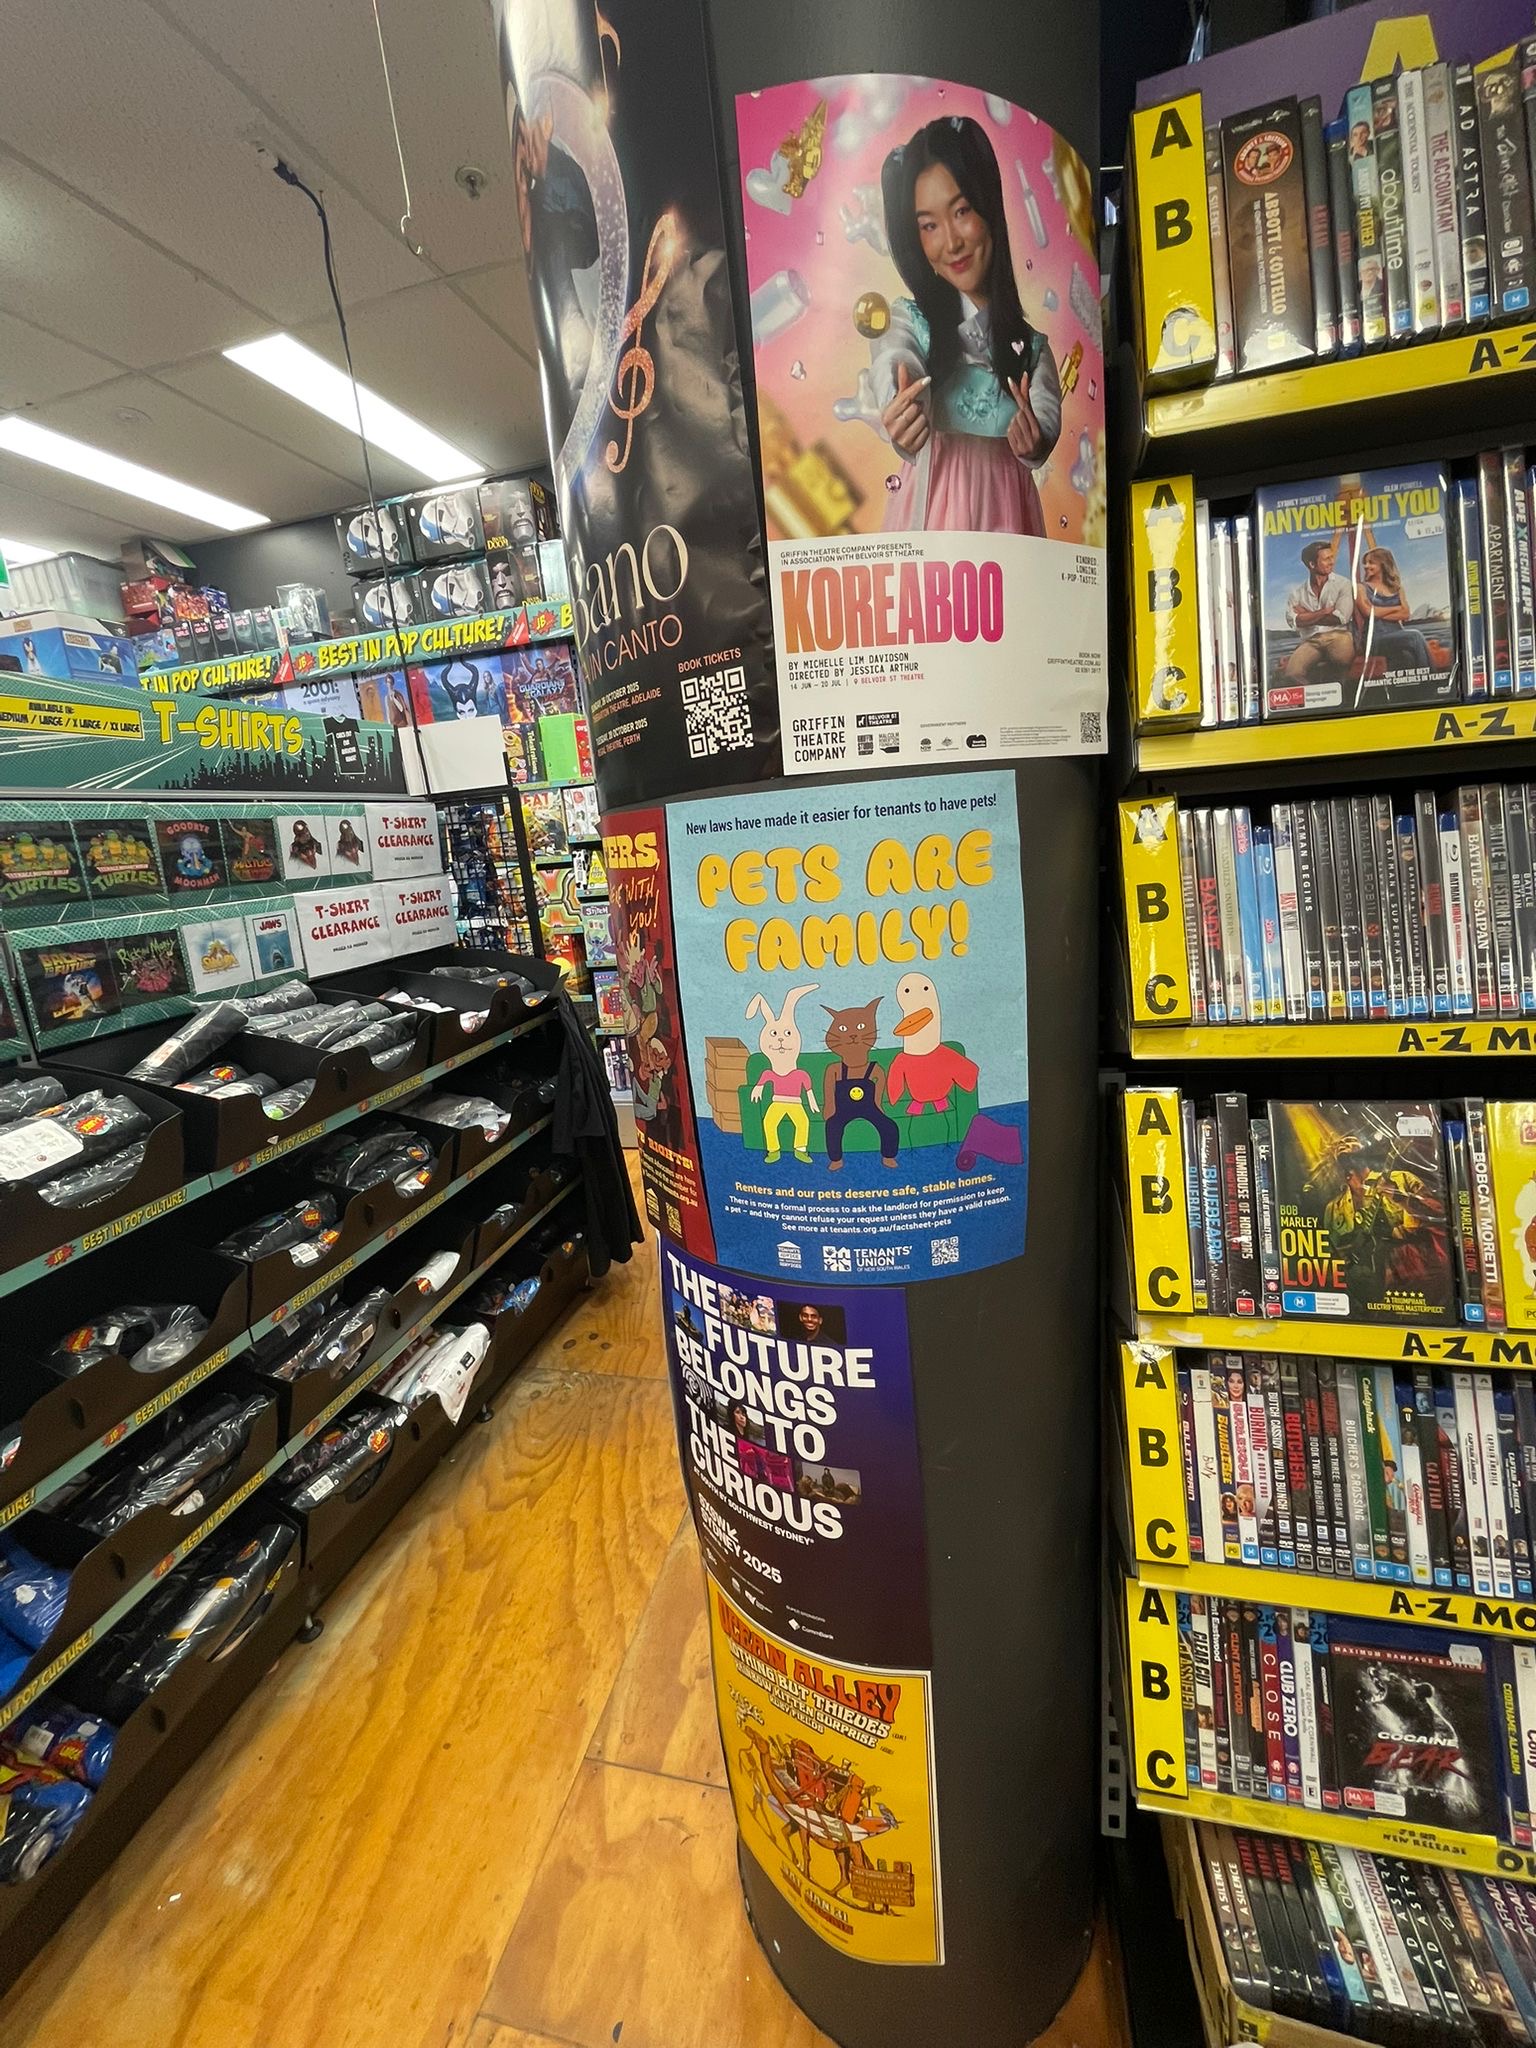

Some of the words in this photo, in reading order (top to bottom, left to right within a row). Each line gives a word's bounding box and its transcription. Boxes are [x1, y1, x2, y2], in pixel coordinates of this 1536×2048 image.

[1150, 107, 1193, 160] A
[1459, 104, 1474, 132] AD
[1431, 130, 1448, 155] THE
[1432, 155, 1455, 235] ACCOUNTANT
[1463, 147, 1480, 218] ASTRA
[1154, 198, 1194, 251] B
[1160, 313, 1206, 358] C
[1146, 483, 1185, 525] A
[1263, 499, 1347, 538] ANYONE
[1351, 494, 1391, 525] BUT
[1395, 486, 1441, 517] YOU
[780, 551, 808, 559] GRIFFIN
[809, 548, 841, 557] THEATRE
[841, 545, 875, 554] COMPANY
[876, 543, 913, 551] PRESENTS
[1488, 523, 1506, 601] APARTMENT
[780, 560, 1004, 655] KOREABOO
[1147, 567, 1182, 613] B
[298, 657, 309, 671] JB
[318, 643, 360, 669] BEST
[363, 641, 382, 662] IN
[384, 632, 418, 658] POP
[421, 615, 505, 652] CULTURE!
[589, 656, 603, 682] IN
[604, 614, 683, 671] CANTO
[678, 658, 702, 673] BOOK
[703, 648, 742, 667] TICKETS
[788, 661, 799, 671] BY
[803, 657, 844, 669] MICHELLE
[848, 655, 866, 666] LIM
[153, 675, 170, 694] IN
[172, 669, 200, 693] POP
[202, 656, 272, 688] CULTURE!
[301, 678, 340, 698] 2001:
[789, 669, 830, 681] DIRECTED
[834, 668, 845, 677] BY
[850, 664, 885, 676] JESSICA
[889, 662, 919, 673] ARTHUR
[1150, 665, 1189, 712] C
[792, 715, 845, 732] GRIFFIN
[793, 731, 846, 748] THEATRE
[1434, 706, 1515, 743] A-Z
[794, 746, 847, 763] COMPANY
[166, 821, 210, 835] GOODBYE
[382, 816, 427, 831] T-SHIRT
[686, 822, 707, 835] New
[709, 819, 733, 833] laws
[735, 816, 762, 831] have
[764, 812, 798, 828] made
[800, 810, 809, 825] it
[812, 807, 850, 823] easier
[853, 805, 872, 819] for
[875, 801, 922, 817] tenants
[924, 799, 937, 812] to
[939, 797, 968, 811] have
[970, 793, 998, 812] pets!
[1133, 803, 1169, 844] A
[1297, 808, 1309, 858] BATMAN
[377, 833, 434, 849] CLEARANCE
[1, 876, 82, 901] TURTLES
[91, 870, 159, 893] TURTLES
[173, 873, 221, 889] MOONMEN
[697, 843, 843, 909] PETS
[865, 828, 995, 897] ARE
[1301, 864, 1313, 912] BEGINS
[315, 898, 370, 919] T-SHIRT
[398, 889, 442, 906] T-SHIRT
[626, 875, 655, 905] WITH
[1136, 882, 1170, 924] B
[259, 918, 282, 932] JAWS
[311, 915, 381, 942] CLEARANCE
[395, 905, 450, 926] CLEARANCE
[629, 888, 660, 945] YOU!
[1199, 877, 1222, 951] BANDIT
[724, 898, 971, 974] FAMILY!
[1145, 974, 1179, 1016] C
[1397, 1026, 1472, 1053] A-Z
[1137, 1097, 1172, 1137] A
[735, 1181, 773, 1195] Renters
[775, 1187, 795, 1198] and
[797, 1190, 815, 1199] our
[817, 1189, 842, 1201] pets
[844, 1189, 890, 1199] deserve
[892, 1184, 920, 1197] safe,
[922, 1179, 956, 1194] stable
[958, 1173, 996, 1188] homes.
[1234, 1144, 1250, 1200] BLUMHOUSE
[1472, 1151, 1491, 1215] BOBCAT
[1140, 1174, 1174, 1215] B
[1239, 1201, 1250, 1214] OF
[1280, 1205, 1298, 1216] BOB
[82, 1224, 110, 1251] BEST
[111, 1219, 124, 1237] IN
[125, 1210, 145, 1234] POP
[144, 1188, 188, 1223] CULTURE!
[781, 1223, 797, 1231] See
[798, 1225, 818, 1233] more
[830, 1218, 952, 1234] tenants.org.au/factsheet-pets
[1238, 1215, 1254, 1260] HORRORS
[1280, 1216, 1318, 1229] MARLEY
[853, 1245, 913, 1258] TENANTS'
[856, 1256, 895, 1267] UNION
[1280, 1229, 1332, 1258] ONE
[1480, 1216, 1498, 1285] MORETTI
[666, 1251, 721, 1318] THE
[1148, 1266, 1182, 1308] C
[1282, 1257, 1349, 1289] LOVE
[703, 1314, 876, 1389] FUTURE
[1402, 1332, 1475, 1362] A-Z
[675, 1324, 838, 1427] BELONGS
[1134, 1360, 1167, 1390] A
[1361, 1376, 1376, 1434] Caddyshack
[684, 1393, 741, 1469] THE
[764, 1413, 827, 1462] TO
[1138, 1427, 1169, 1468] B
[1182, 1420, 1193, 1464] BULLET
[1216, 1413, 1233, 1486] BUMBLEBEE
[1232, 1402, 1250, 1482] BURLESQUE
[1285, 1411, 1307, 1491] BUTCHERS
[689, 1431, 844, 1540] CURIOUS
[1184, 1464, 1196, 1502] TRAIN
[1146, 1518, 1178, 1559] C
[743, 1549, 783, 1585] 2025
[1138, 1589, 1171, 1626] A
[1389, 1590, 1459, 1624] A-Z
[779, 1674, 810, 1700] BUT
[794, 1658, 901, 1724] ALLEY
[1142, 1661, 1171, 1700] B
[1262, 1653, 1282, 1742] CLOSE
[1279, 1660, 1295, 1695] CLUB
[773, 1685, 815, 1718] KITTEN
[816, 1710, 879, 1750] SURPRISE
[1283, 1695, 1298, 1738] ZERO
[1377, 1731, 1459, 1750] COCAINE
[1147, 1748, 1177, 1789] C
[1363, 1742, 1472, 1783] BEAR
[1383, 1833, 1413, 1847] NEW
[1415, 1837, 1468, 1856] RELEASE
[1484, 1876, 1518, 1933] AFRAID
[1503, 1881, 1536, 1937] AFRAID
